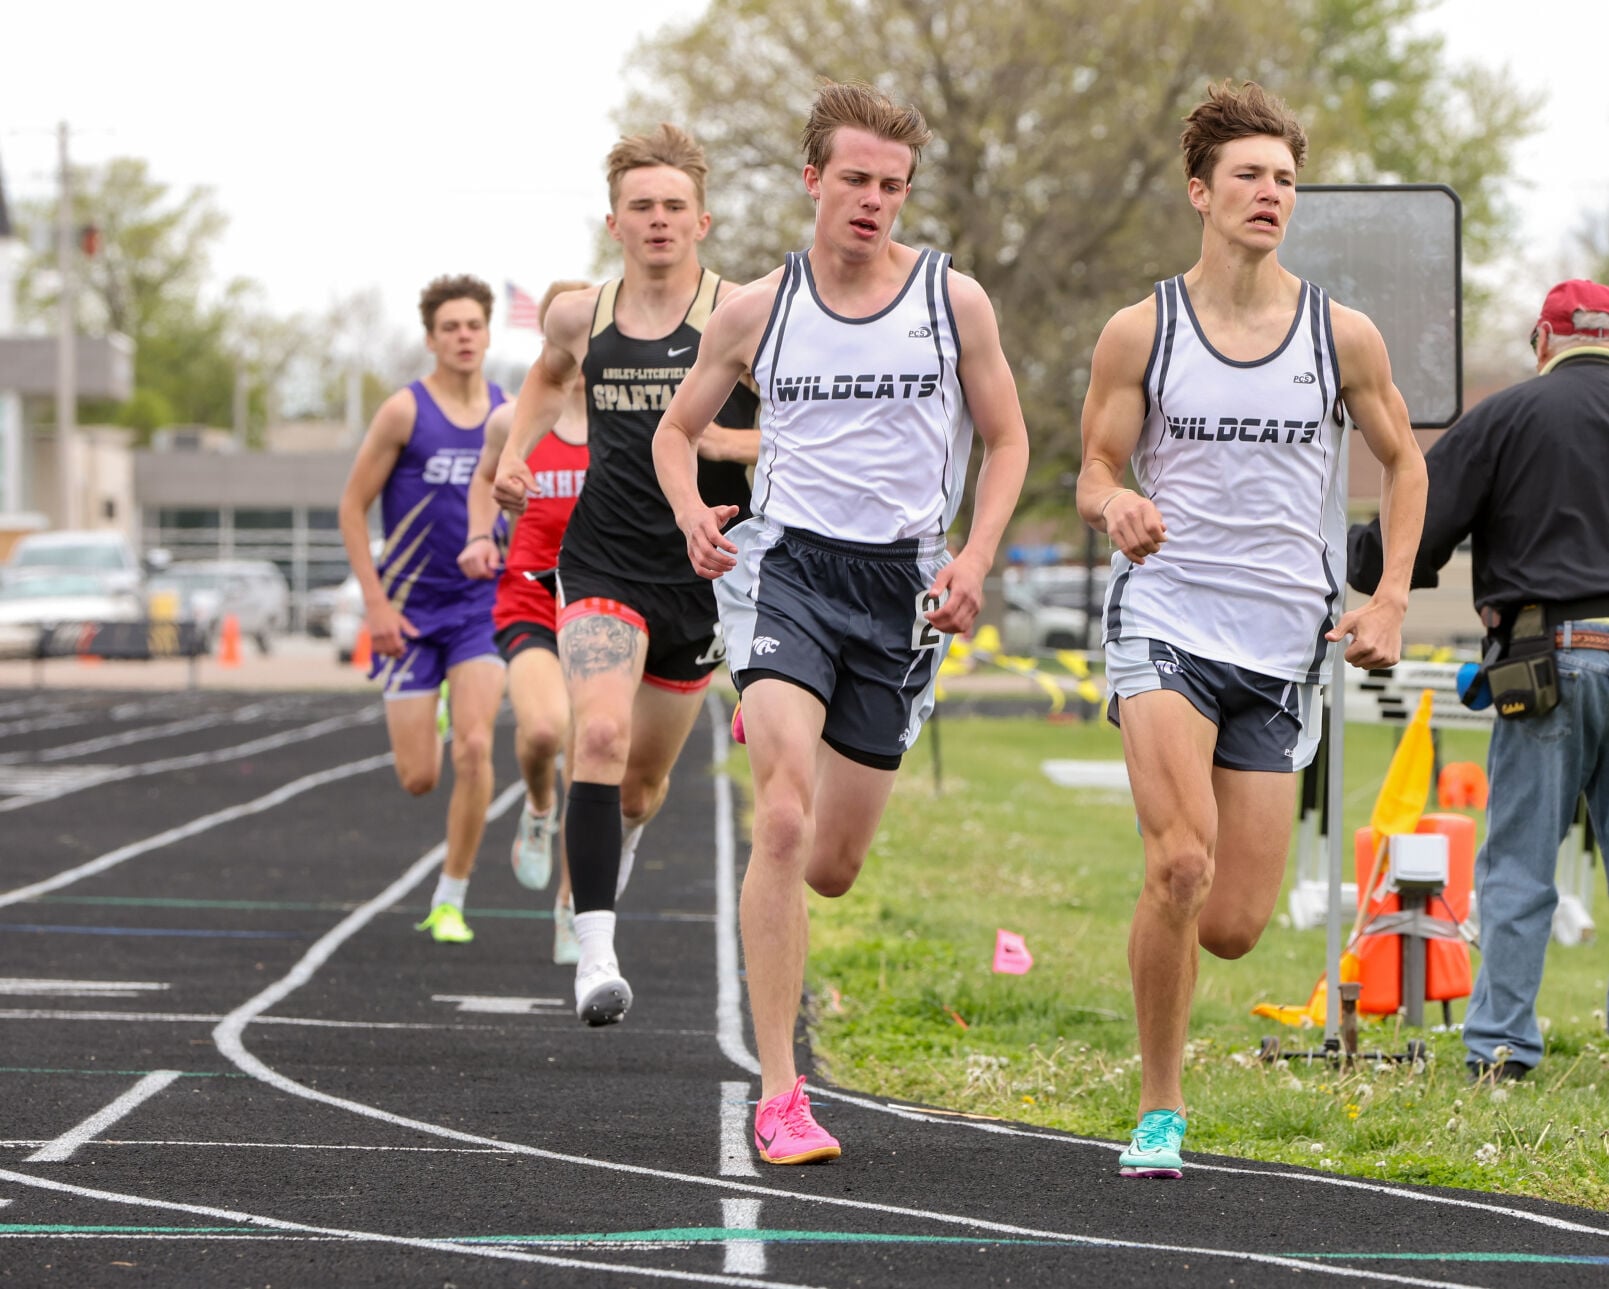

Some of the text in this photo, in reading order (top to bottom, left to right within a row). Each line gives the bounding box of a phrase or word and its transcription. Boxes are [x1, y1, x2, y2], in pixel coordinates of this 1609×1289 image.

[592, 384, 682, 411] SPARTA
[776, 374, 939, 402] WILDCATS
[1167, 416, 1320, 444] WILDCATS
